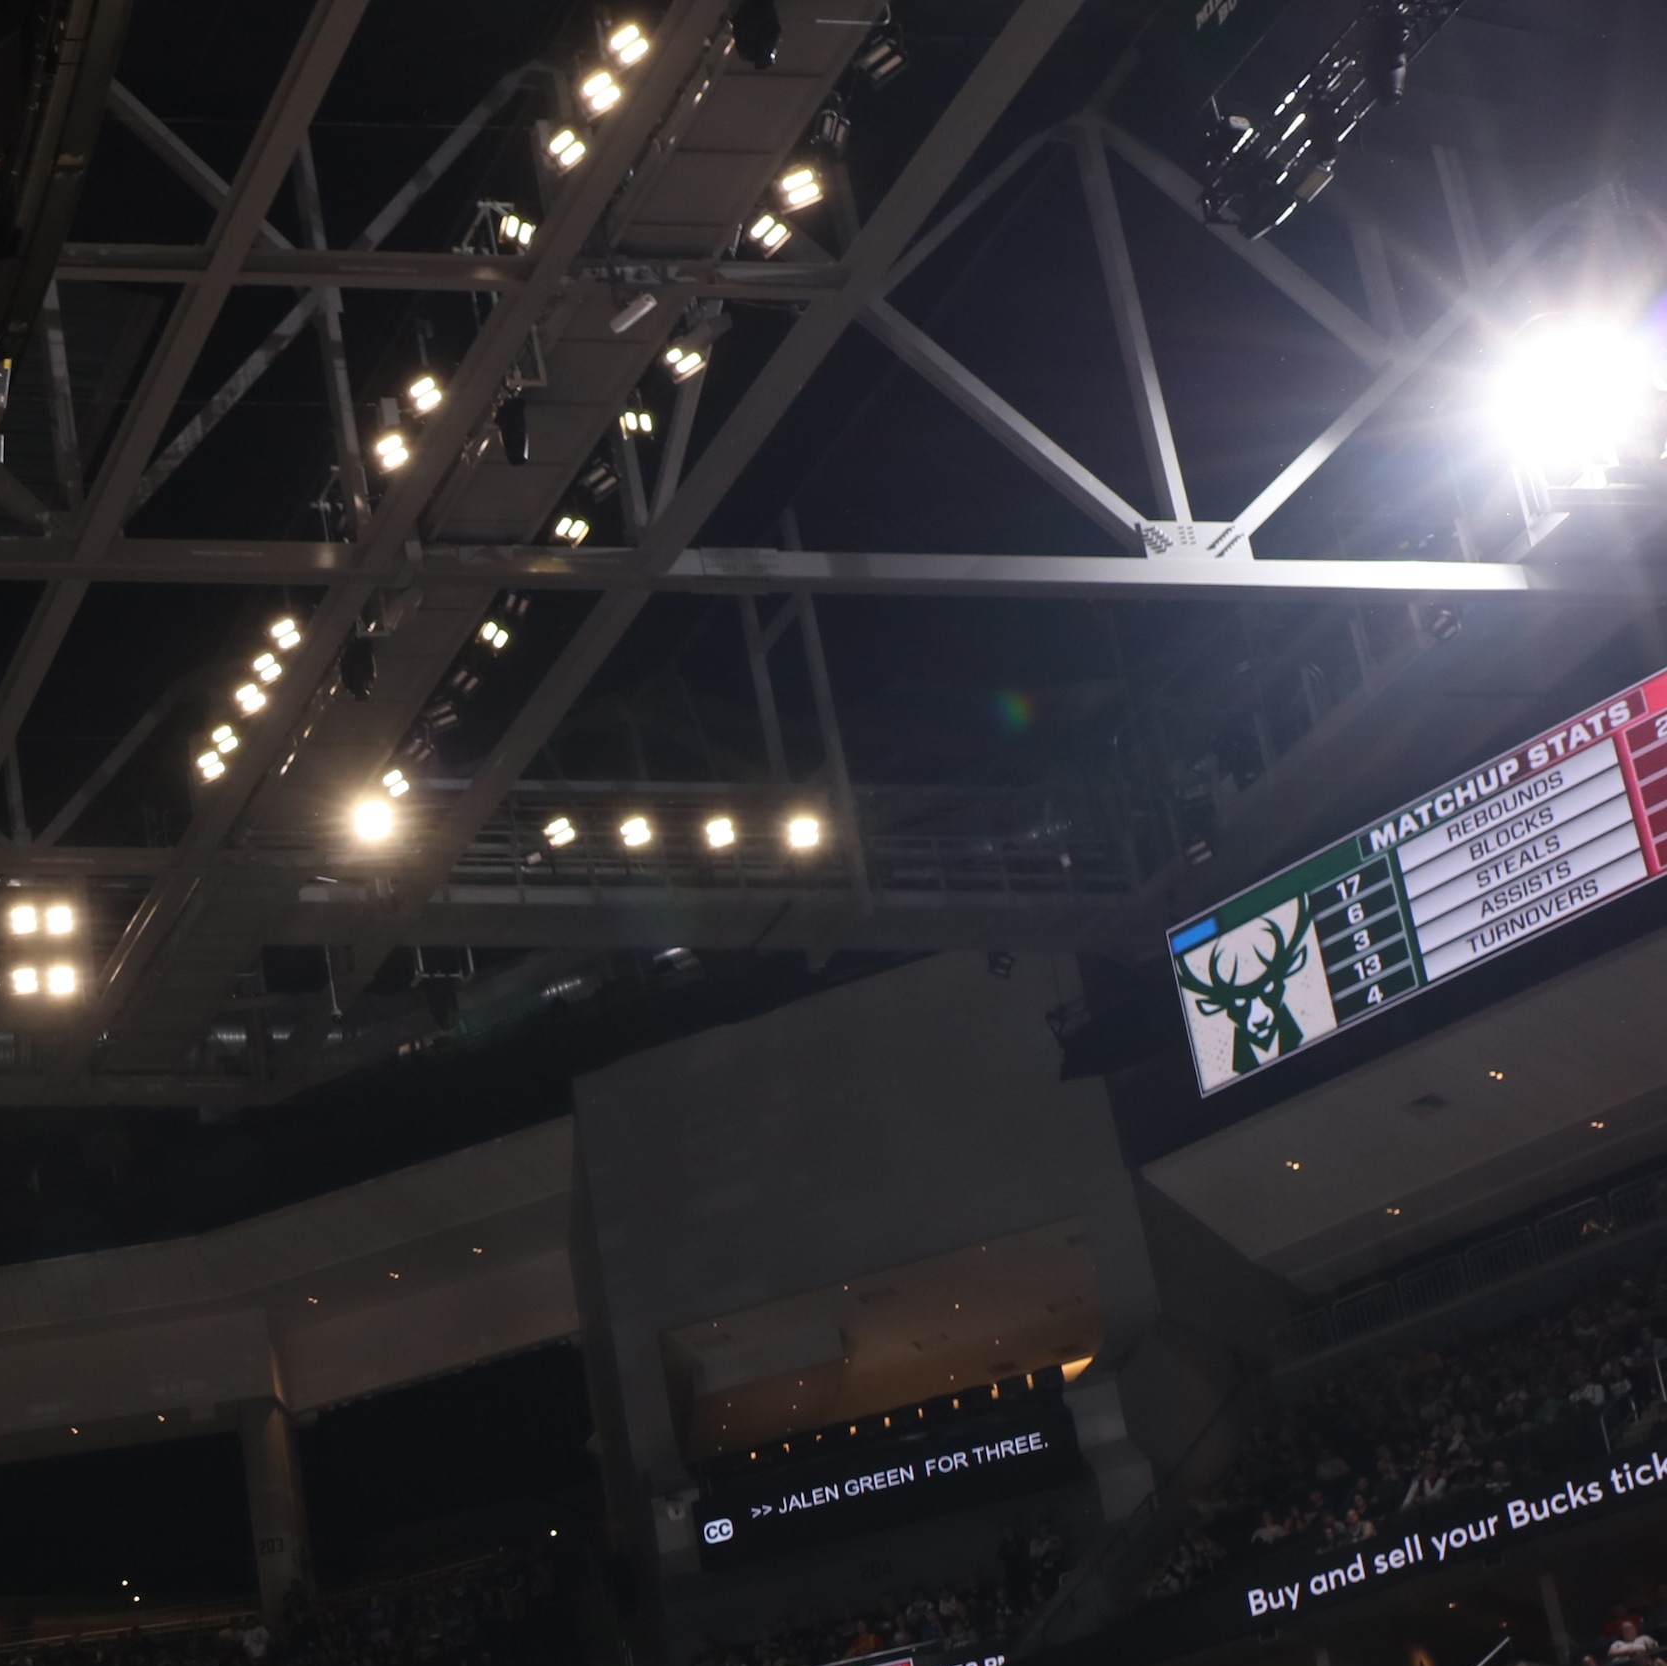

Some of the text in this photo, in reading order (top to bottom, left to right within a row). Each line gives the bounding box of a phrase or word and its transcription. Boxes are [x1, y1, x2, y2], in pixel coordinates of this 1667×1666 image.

[1336, 771, 1564, 900] 17 REBOUNDS
[1369, 700, 1631, 852] MATCHUP STATS
[1347, 807, 1554, 925] 6 BLOCKS
[1353, 835, 1561, 951] 3 STEALS
[1353, 861, 1571, 980] 13 ASSISTS
[1367, 879, 1599, 1004] 4 TURNOVERS
[705, 1520, 732, 1541] CC
[778, 1431, 1049, 1514] JALEN GREEN FOR THREE.
[1248, 1480, 1604, 1617] Buy and sell your Bucks
